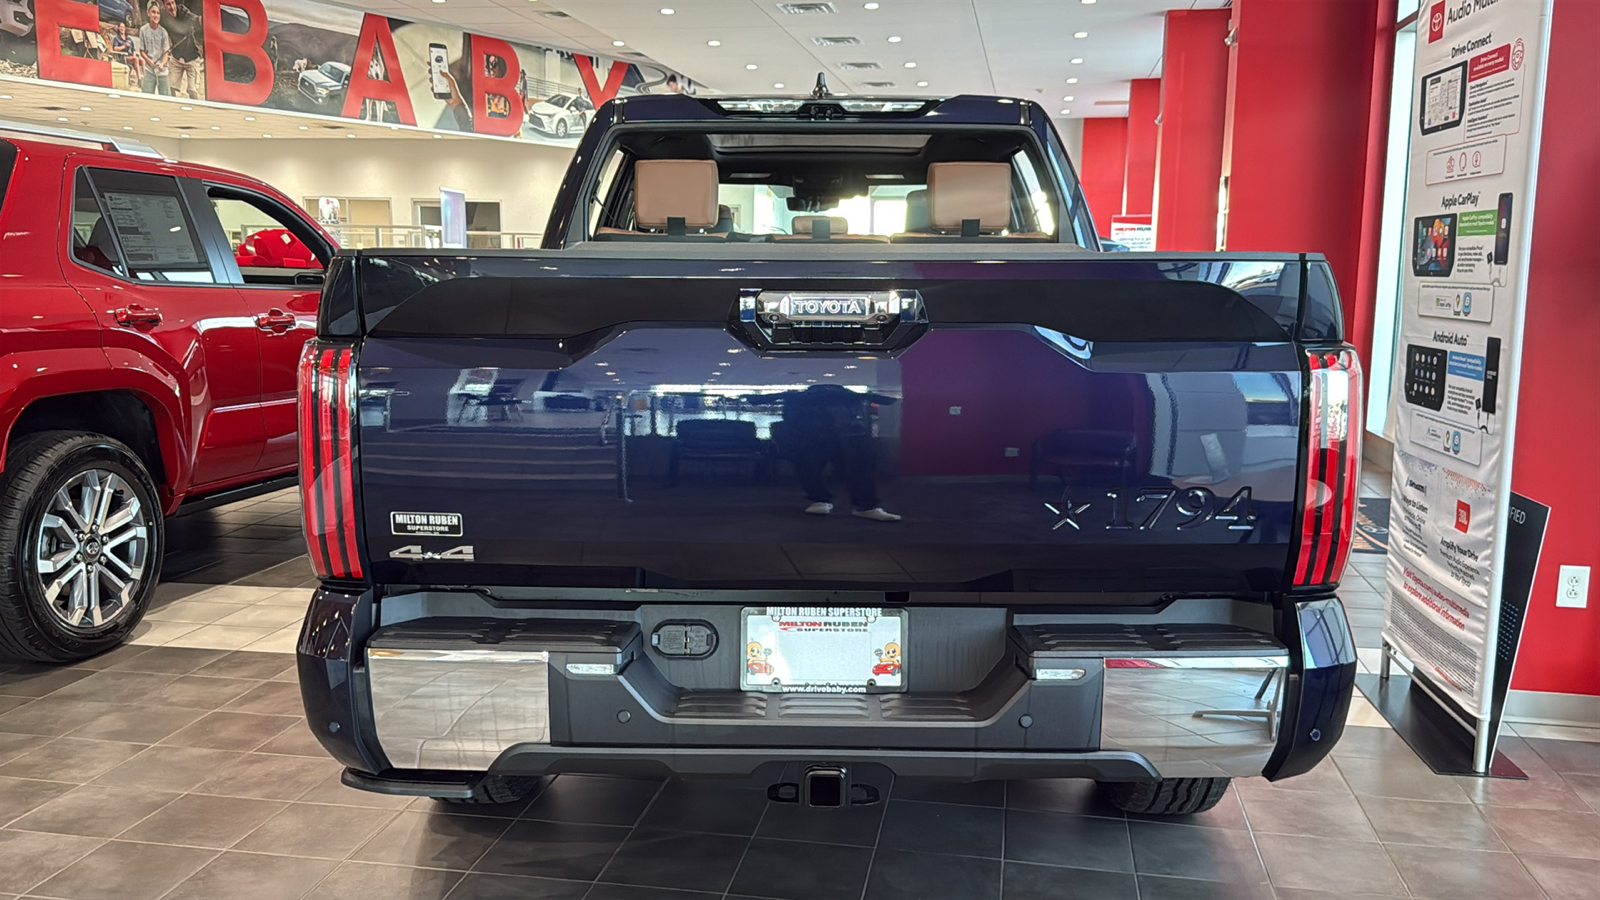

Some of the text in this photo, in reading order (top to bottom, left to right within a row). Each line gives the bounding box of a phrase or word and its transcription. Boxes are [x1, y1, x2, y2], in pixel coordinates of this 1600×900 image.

[1446, 0, 1472, 25] Audio
[1451, 32, 1492, 59] Drive Connect
[1441, 194, 1457, 210] Apple
[795, 300, 861, 314] TOYOTA
[1433, 330, 1454, 345] Android
[1105, 486, 1257, 531] 1794
[395, 514, 459, 526] MILTON RUBEN
[766, 607, 883, 618] MILTON RUBEN SUPERSTORE
[782, 685, 867, 694] www.drivebaby.com
